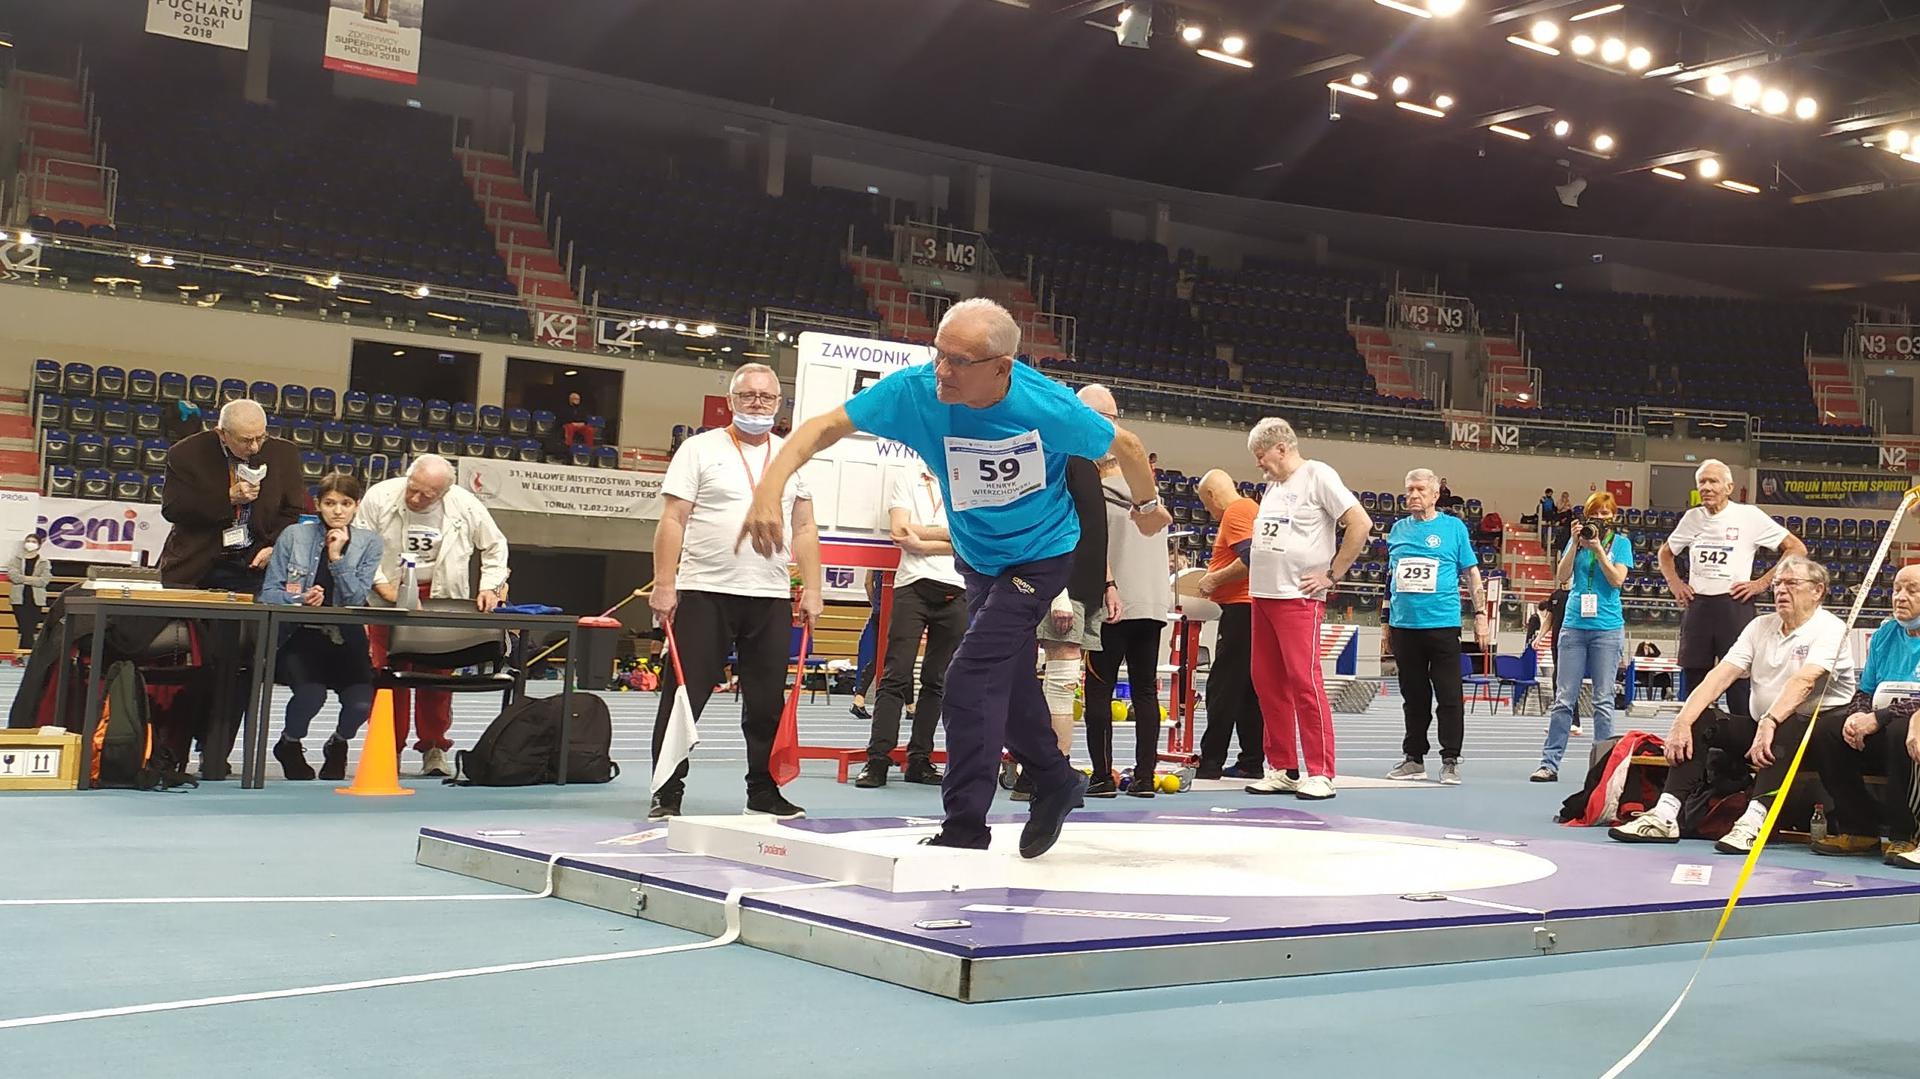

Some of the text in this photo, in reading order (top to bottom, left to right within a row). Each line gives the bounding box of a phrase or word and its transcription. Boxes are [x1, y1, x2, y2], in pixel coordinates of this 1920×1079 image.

[174, 11, 225, 29] POLSKI
[183, 25, 213, 39] 2018
[334, 35, 411, 57] SUPERPUCHARU
[344, 45, 401, 62] POLSKI 2018
[911, 236, 976, 266] L3 M3
[1400, 303, 1463, 328] M3 N3
[537, 311, 634, 347] K2 L2
[1860, 335, 1887, 354] N3
[821, 342, 912, 366] ZAWODNIK
[1451, 422, 1519, 446] M2 N2
[1879, 447, 1907, 466] N2
[979, 458, 1021, 482] 59
[525, 471, 564, 482] HALOWE
[566, 475, 631, 487] MISTRZOSTWA
[634, 479, 663, 489] POLSK
[986, 481, 1017, 489] HENRYK
[1784, 478, 1909, 493] TORUŃ MIASTEM SPORTU
[532, 482, 567, 493] LEKKIEJ
[569, 486, 613, 497] ATLETYCE
[616, 489, 657, 499] MASTERS
[1261, 522, 1279, 537] 32
[1699, 550, 1728, 565] 542
[1403, 567, 1431, 580] 293
